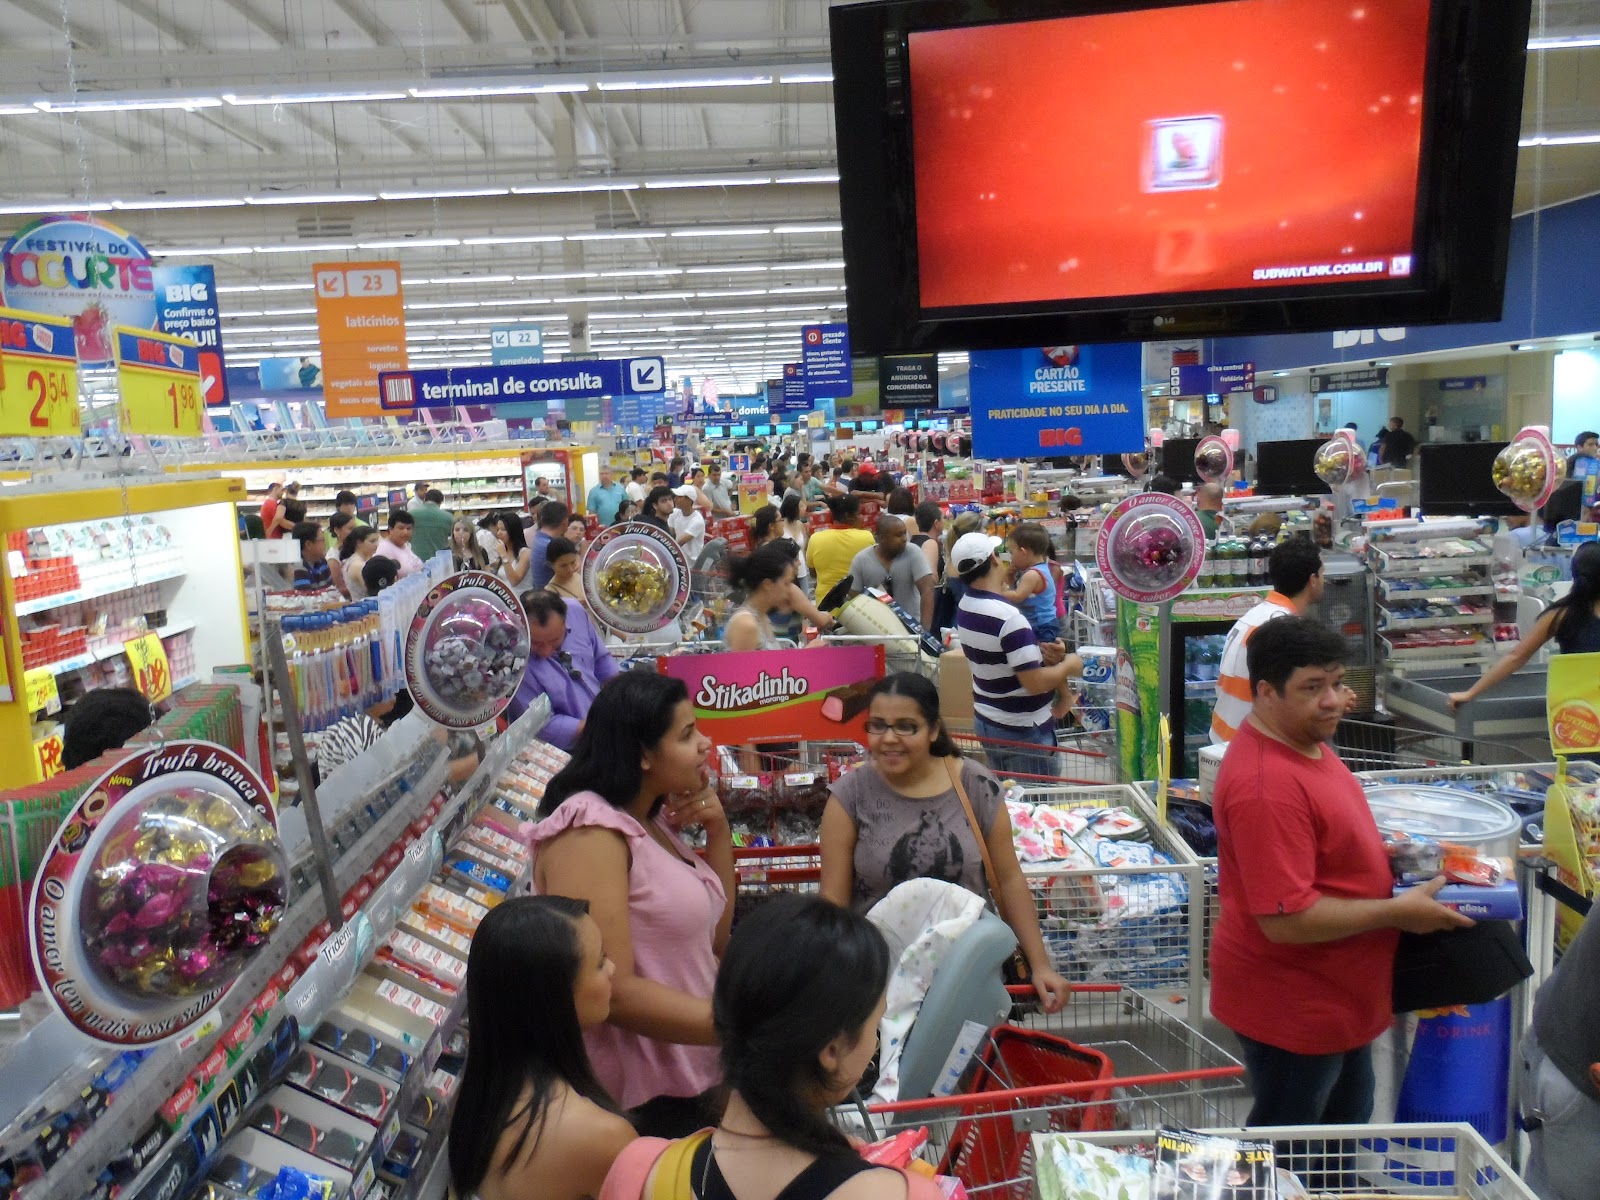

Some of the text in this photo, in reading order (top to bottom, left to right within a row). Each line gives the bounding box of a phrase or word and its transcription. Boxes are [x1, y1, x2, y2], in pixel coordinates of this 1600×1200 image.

[26, 239, 129, 255] FESTIVAL DO
[3, 251, 154, 292] IOGURTE
[362, 275, 382, 291] 23
[165, 282, 208, 303] BIG
[163, 306, 215, 319] Confirme o
[164, 315, 216, 331] preço baixo
[346, 314, 400, 328] laticínios
[519, 333, 531, 343] 22
[822, 331, 846, 340] prezado
[367, 344, 399, 353] sorvetes
[369, 361, 401, 371] iogurtes
[500, 356, 540, 365] congelados
[1223, 363, 1244, 371] central
[1034, 365, 1079, 381] CARTÃO
[330, 378, 363, 389] vegetais
[421, 371, 602, 400] terminal de consulta
[886, 383, 932, 391] CONCORRÊNCIA
[1029, 380, 1086, 394] PRESENTE
[27, 370, 49, 428] 2
[339, 396, 361, 404] sucos
[1263, 388, 1275, 401] TIM
[168, 382, 178, 428] 1
[181, 385, 195, 409] 98
[988, 403, 1129, 420] PRATICIDADE NO SEU DIA A DIA.
[1039, 426, 1083, 448] BIG
[1138, 496, 1169, 505] amor
[1168, 500, 1186, 515] tem
[624, 524, 649, 535] Trufa
[651, 530, 678, 558] branca
[457, 574, 518, 612] Trufa branca
[1083, 665, 1107, 678] 60
[696, 667, 808, 710] Stikadinho
[759, 694, 790, 706] morango
[108, 774, 134, 788] Novo
[141, 744, 266, 815] Trufa branca e
[44, 878, 66, 901] O
[1459, 903, 1488, 913] Mega
[41, 905, 64, 974] amor
[321, 926, 352, 966] Trident
[53, 977, 86, 1011] tem
[296, 983, 317, 1009] Trident
[84, 1007, 131, 1038] mais
[133, 1014, 178, 1038] esse
